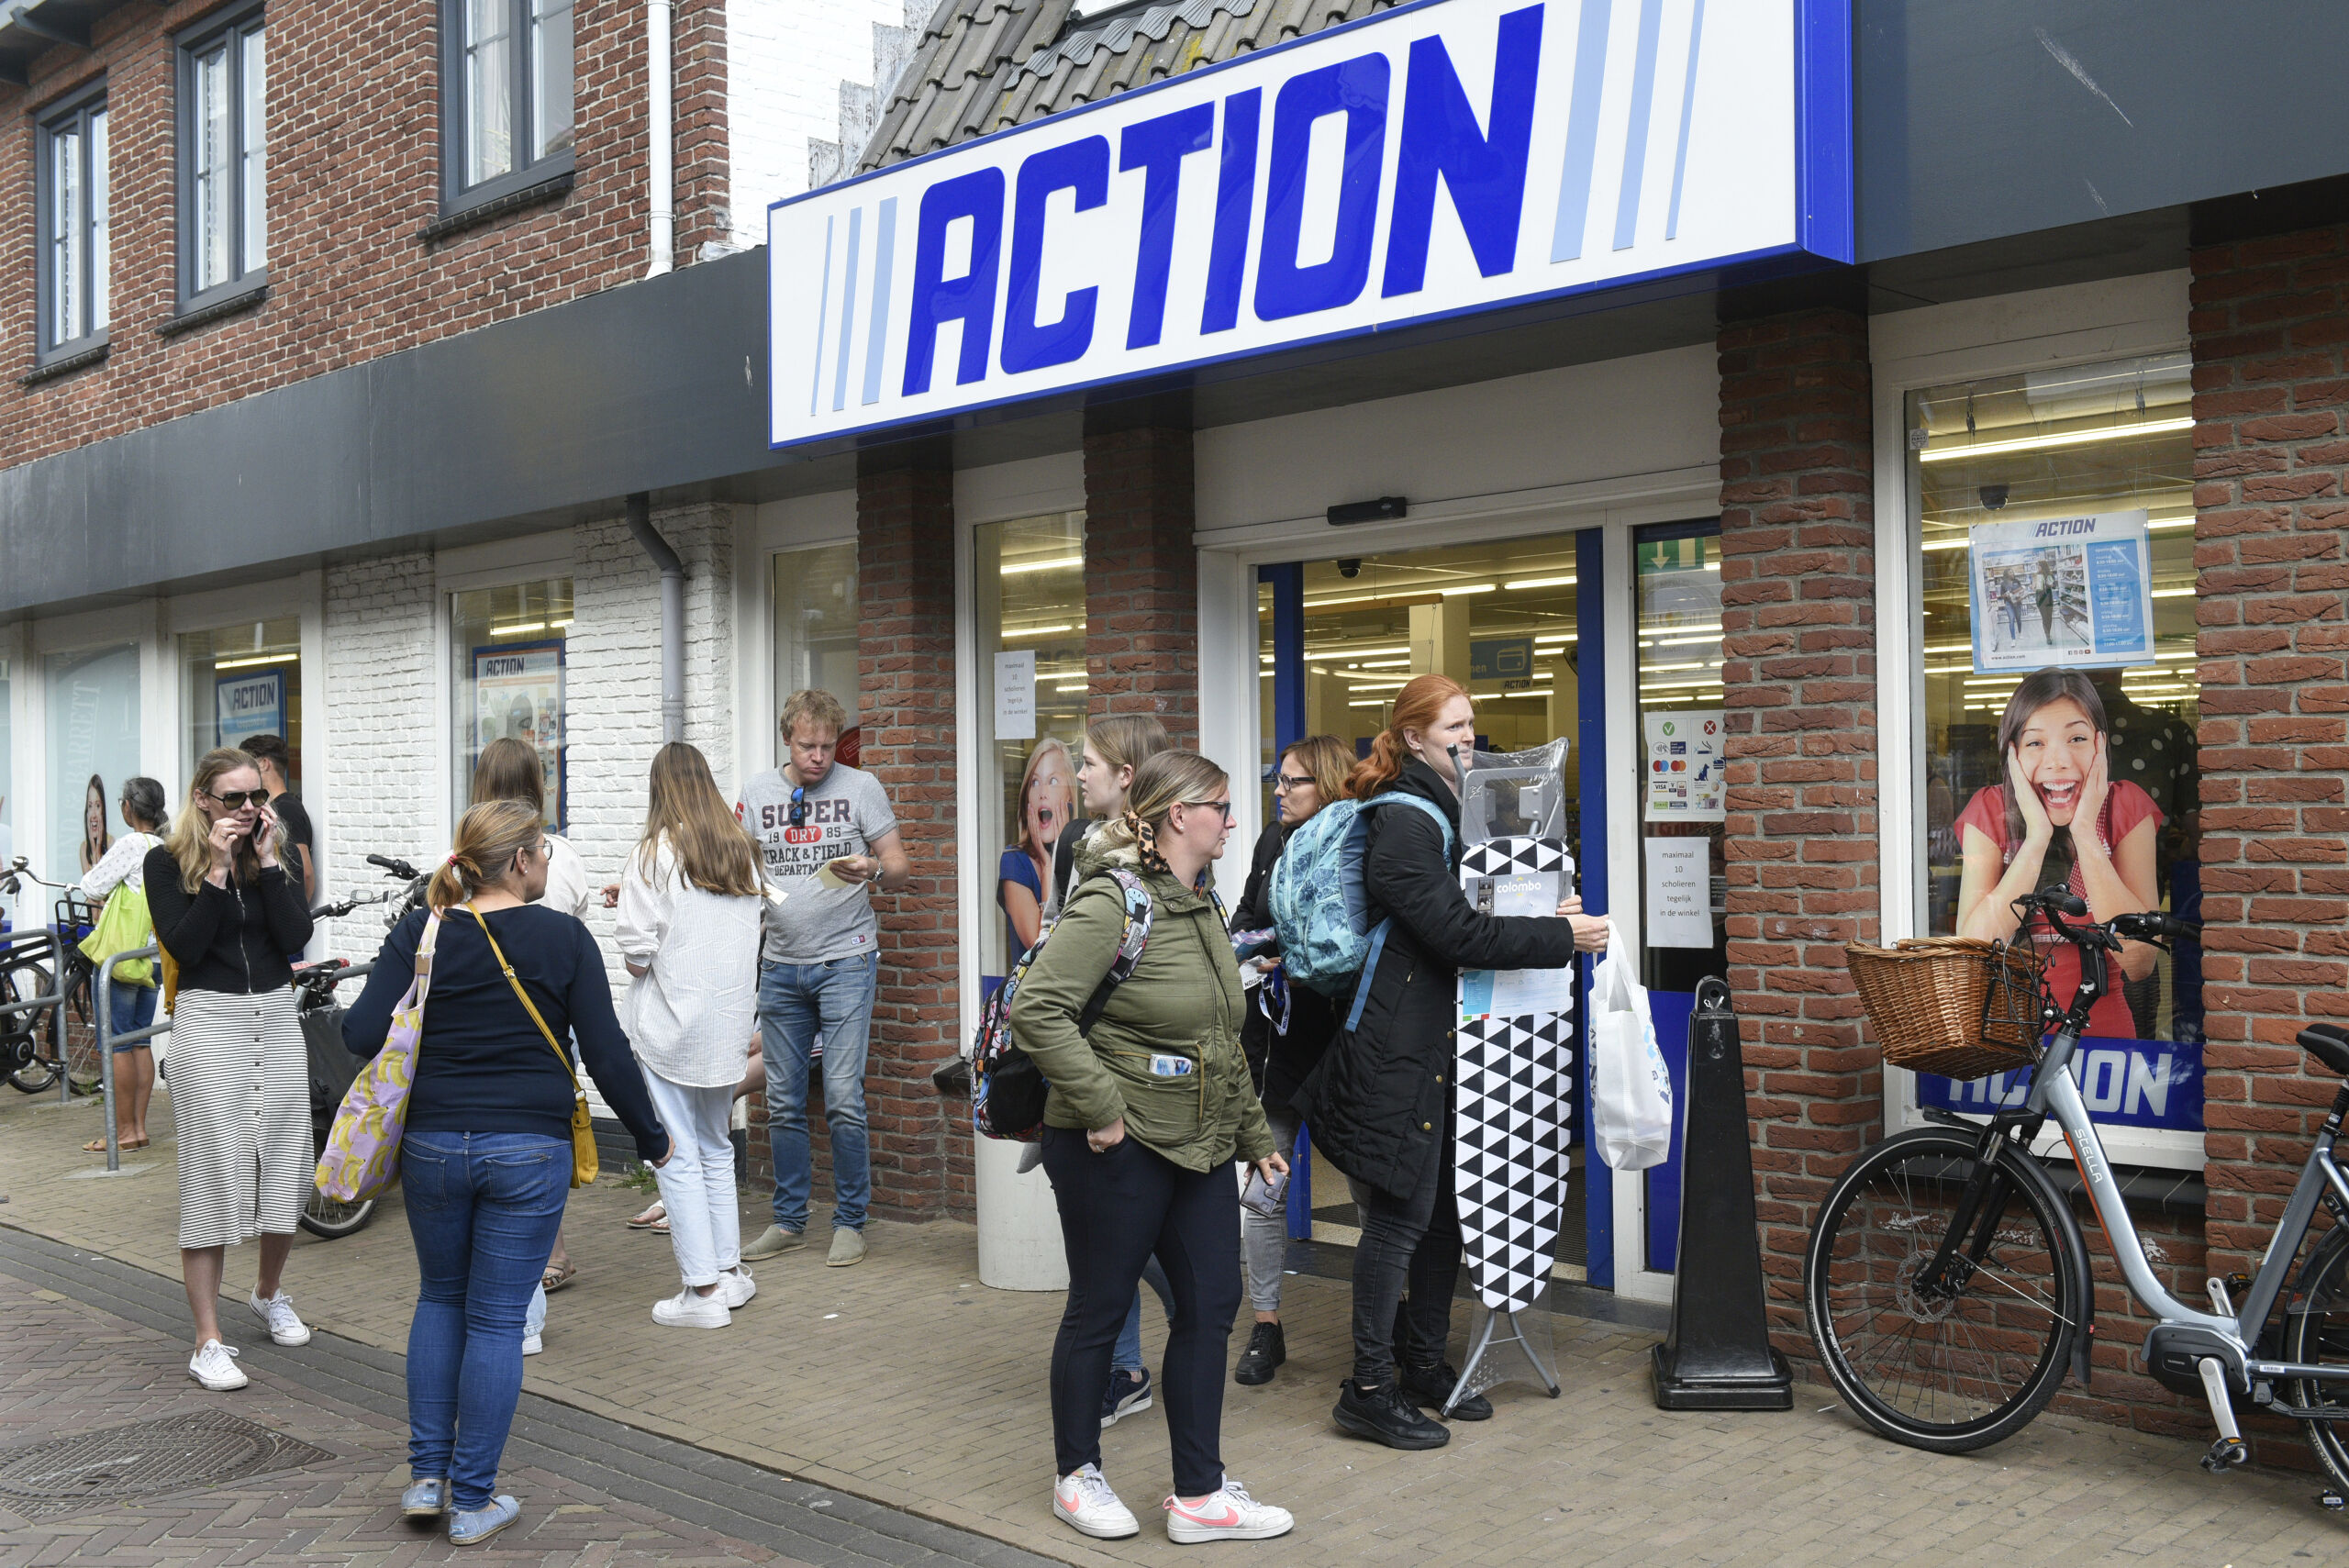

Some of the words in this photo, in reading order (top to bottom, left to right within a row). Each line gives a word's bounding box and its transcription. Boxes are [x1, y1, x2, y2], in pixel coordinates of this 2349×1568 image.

[902, 3, 1544, 396] ACTION
[2035, 517, 2096, 538] ACTION
[486, 657, 525, 677] ACTION
[1504, 679, 1531, 690] ACTION
[232, 682, 275, 712] ACTION
[762, 798, 852, 830] SUPER
[768, 831, 780, 844] 19
[790, 826, 817, 842] DRY
[826, 827, 841, 838] 85
[763, 847, 800, 864] TRACK
[802, 850, 811, 860] &
[812, 841, 852, 861] FIELD
[1675, 865, 1683, 873] 10
[1497, 880, 1542, 894] colombo
[1661, 880, 1696, 888] scholieren
[1666, 895, 1692, 904] tegelijk
